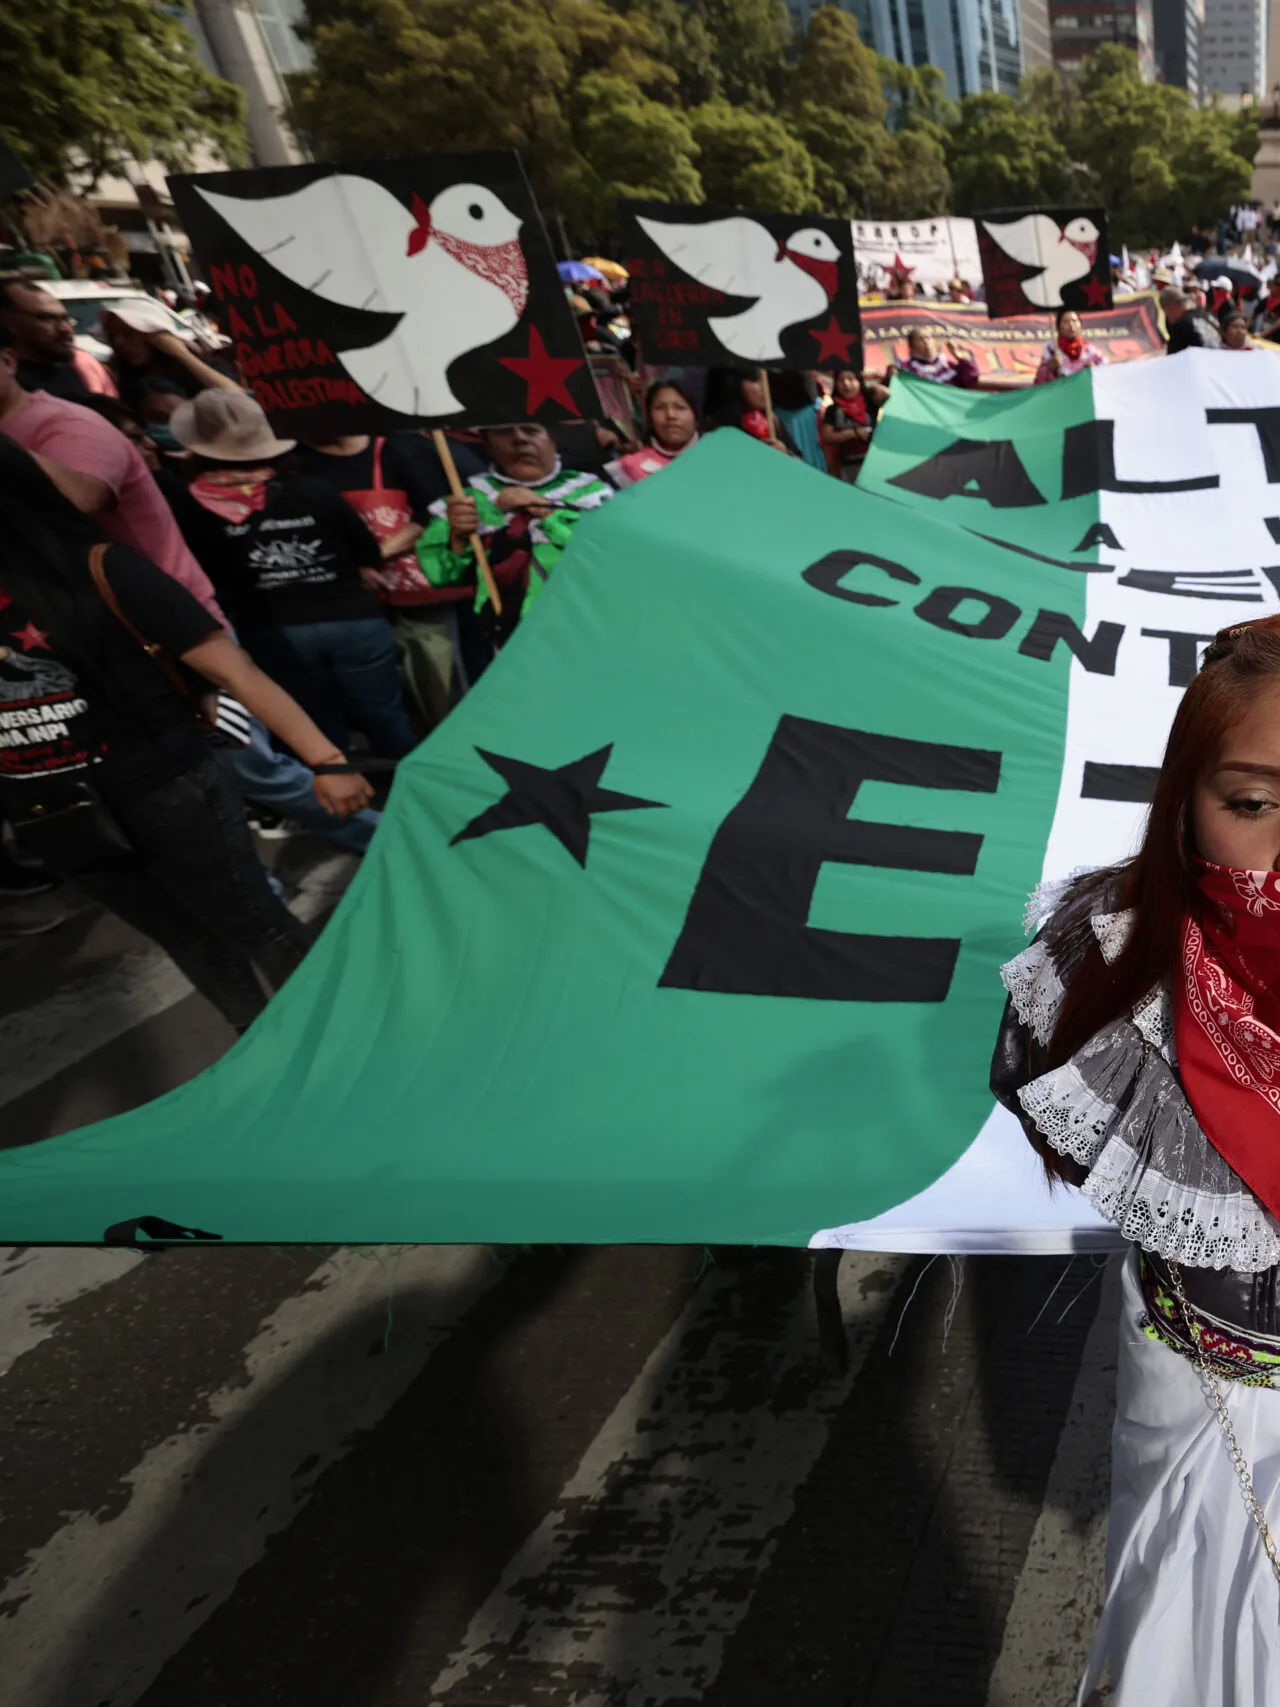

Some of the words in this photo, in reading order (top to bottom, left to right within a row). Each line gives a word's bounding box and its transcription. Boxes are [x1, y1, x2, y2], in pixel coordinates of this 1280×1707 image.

[209, 261, 258, 300] NO
[228, 303, 254, 340] A
[253, 302, 297, 337] LA
[236, 338, 336, 377] GUERRA
[1071, 522, 1126, 552] A
[26, 721, 70, 744] INPI
